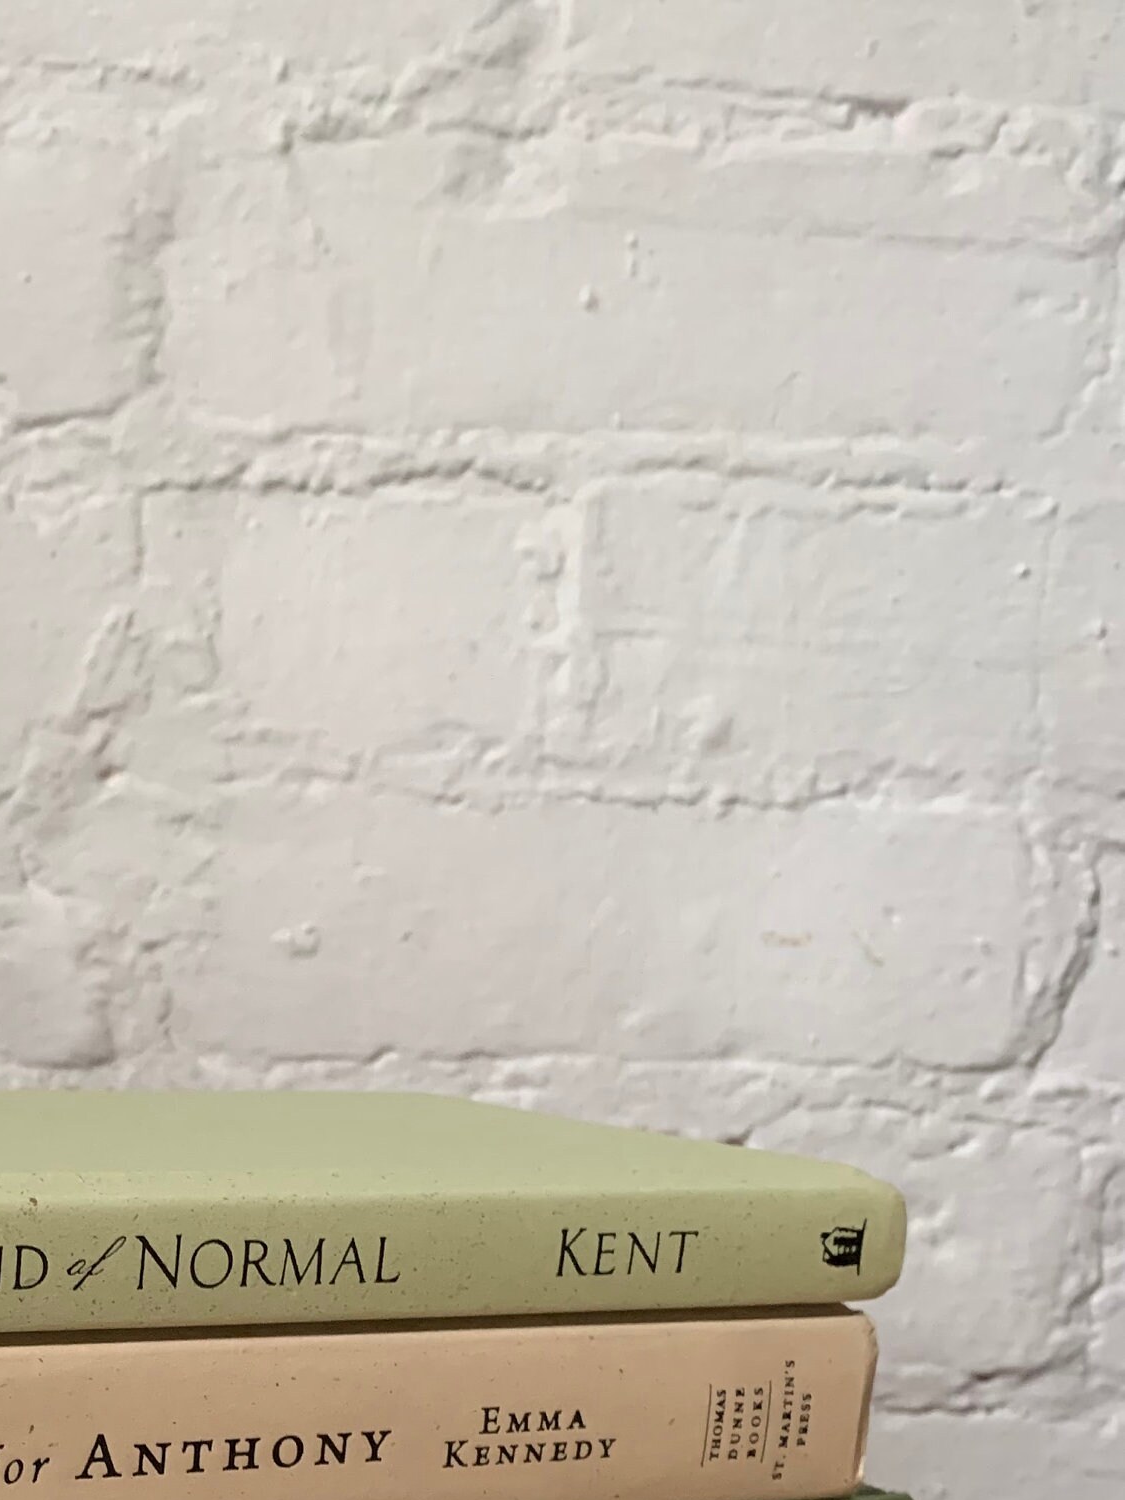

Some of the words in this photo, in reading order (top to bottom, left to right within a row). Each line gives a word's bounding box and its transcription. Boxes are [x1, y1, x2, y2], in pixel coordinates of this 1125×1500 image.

[66, 1235, 127, 1291] of
[135, 1233, 401, 1290] NORMAL
[556, 1228, 698, 1277] KENT
[478, 1406, 586, 1435] EMMA
[709, 1389, 727, 1461] THOMAS
[728, 1387, 745, 1460] DUNNE
[747, 1387, 764, 1459] BOOKS
[778, 1360, 795, 1448] MARTIN'S
[797, 1393, 812, 1447] PRESS
[75, 1430, 392, 1479] ANTHONY
[442, 1438, 616, 1469] KENNEDY
